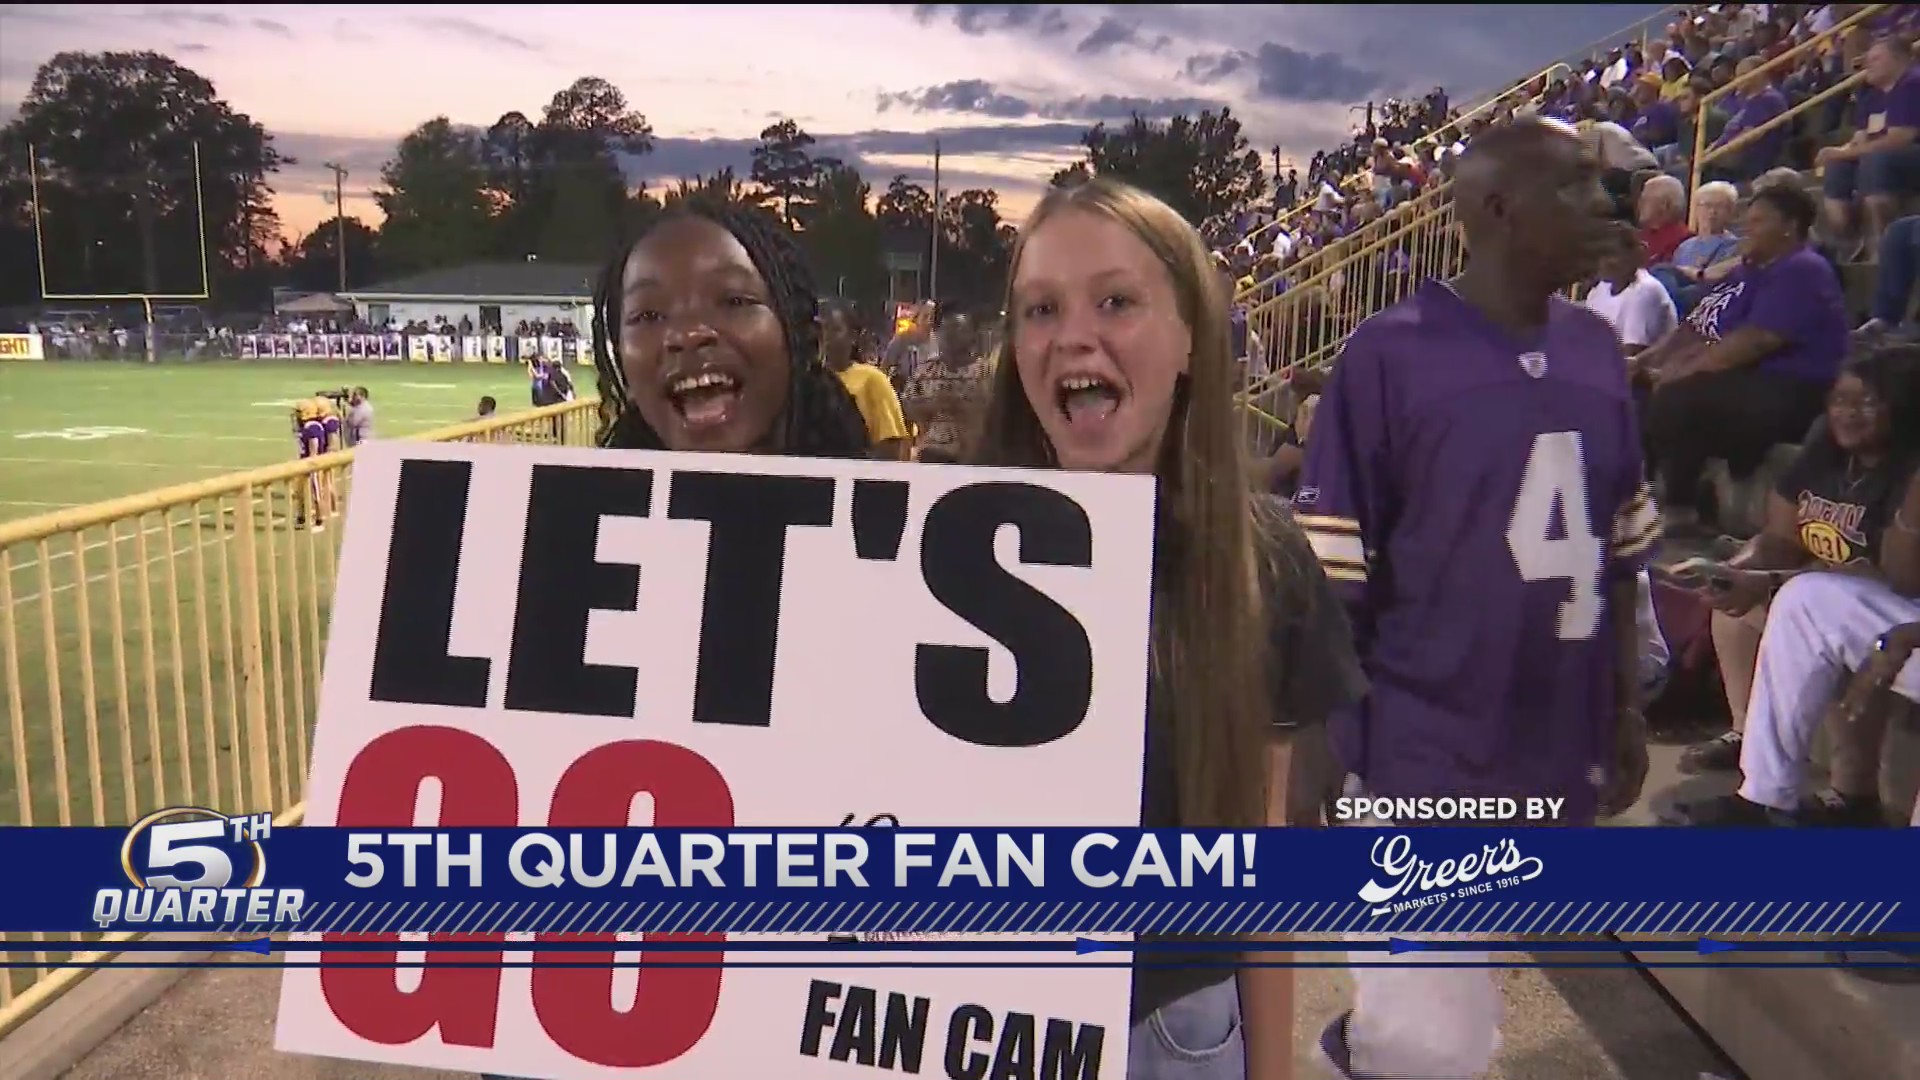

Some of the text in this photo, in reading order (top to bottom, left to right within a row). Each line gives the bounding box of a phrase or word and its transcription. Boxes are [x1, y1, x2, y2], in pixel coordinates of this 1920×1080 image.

[368, 459, 1094, 748] LET'S
[1505, 431, 1606, 641] 4
[319, 724, 736, 1068] GO
[799, 978, 1106, 1080] FAN CAM
